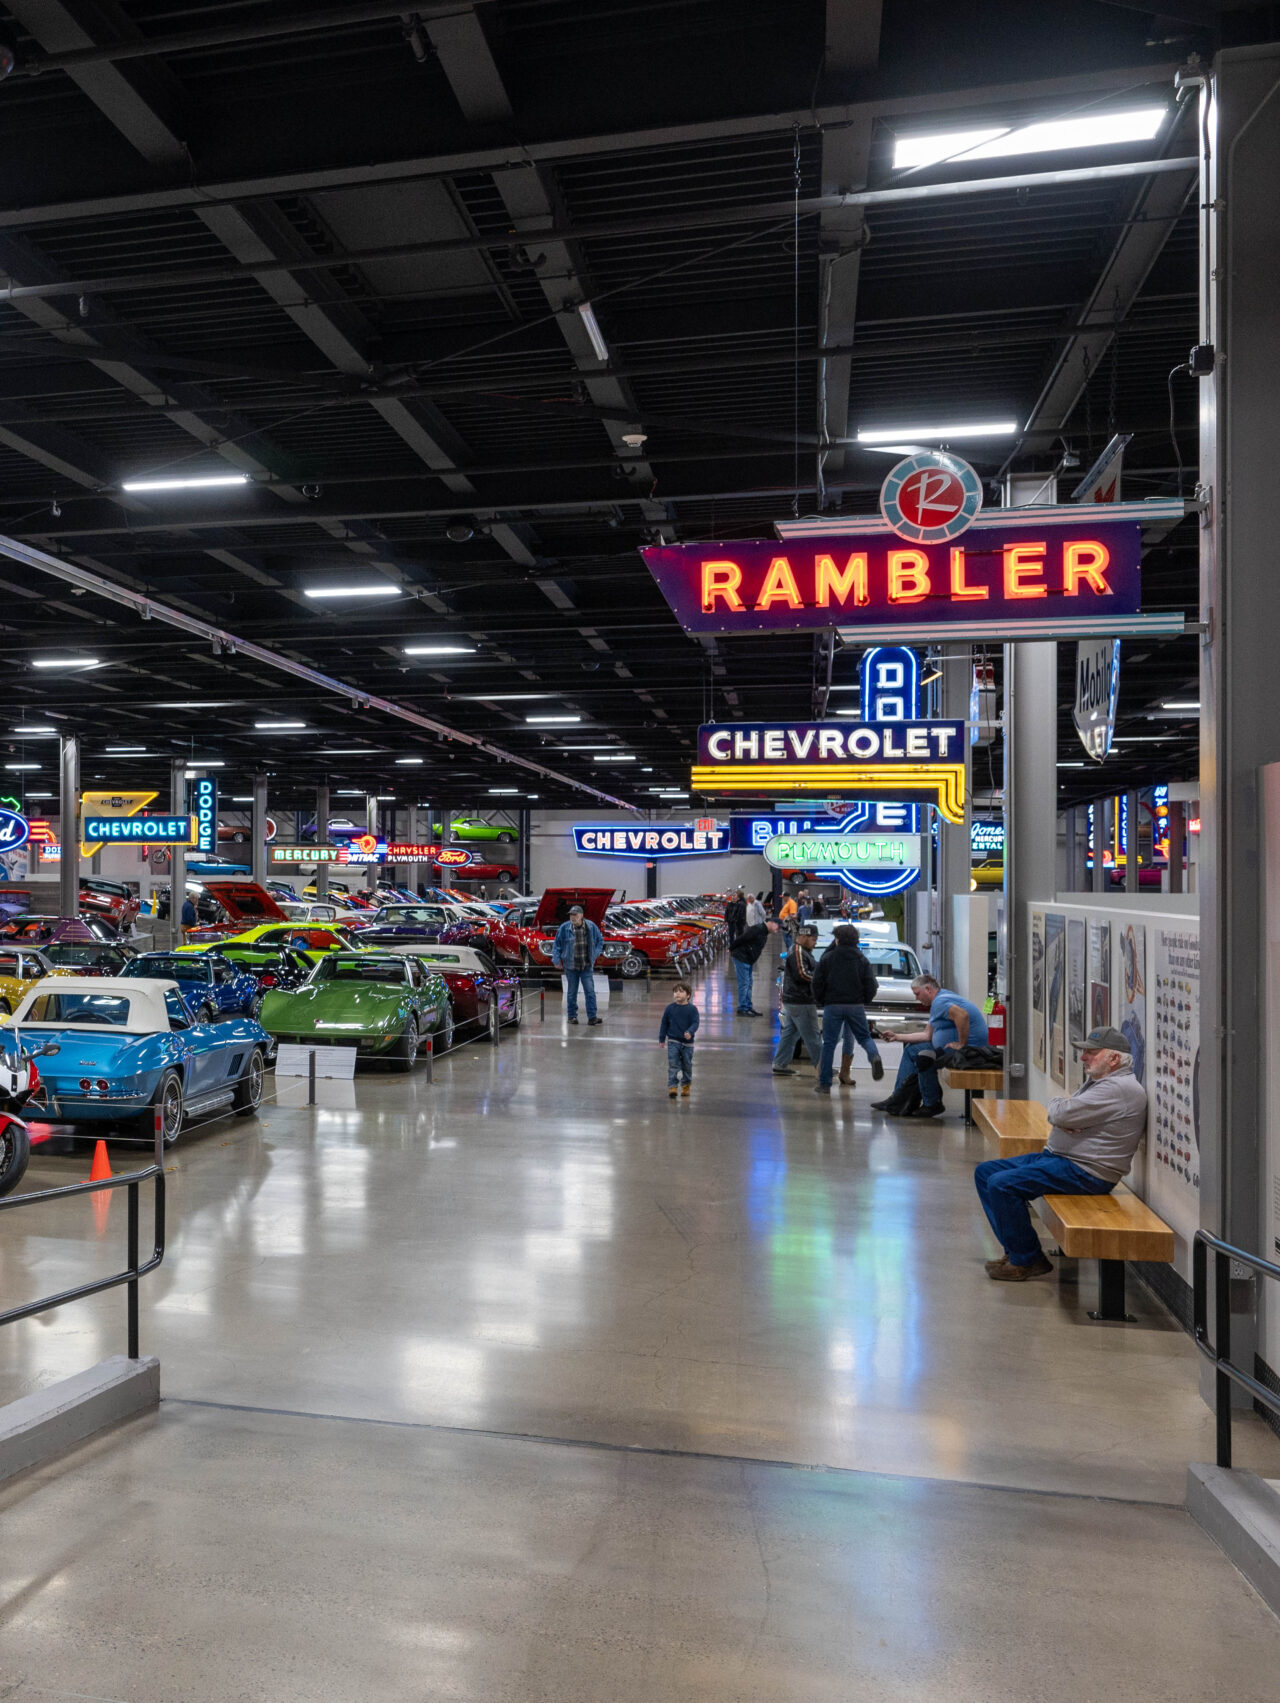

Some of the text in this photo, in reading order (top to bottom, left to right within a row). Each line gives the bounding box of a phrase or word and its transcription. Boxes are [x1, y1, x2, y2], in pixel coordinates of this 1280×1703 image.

[907, 473, 959, 524] R
[701, 540, 1114, 614] RAMBLER
[707, 727, 957, 760] CHEVROLET
[200, 781, 213, 850] DODGE
[88, 821, 187, 837] CHEVROLET
[698, 818, 713, 831] EXIT
[581, 831, 723, 850] CHEVROLET
[274, 848, 338, 860] MERCURY
[387, 846, 436, 855] CHRYSLER
[387, 855, 428, 863] PLYMOUTH
[437, 850, 467, 863] Ford
[778, 841, 905, 862] PLYMOUTH
